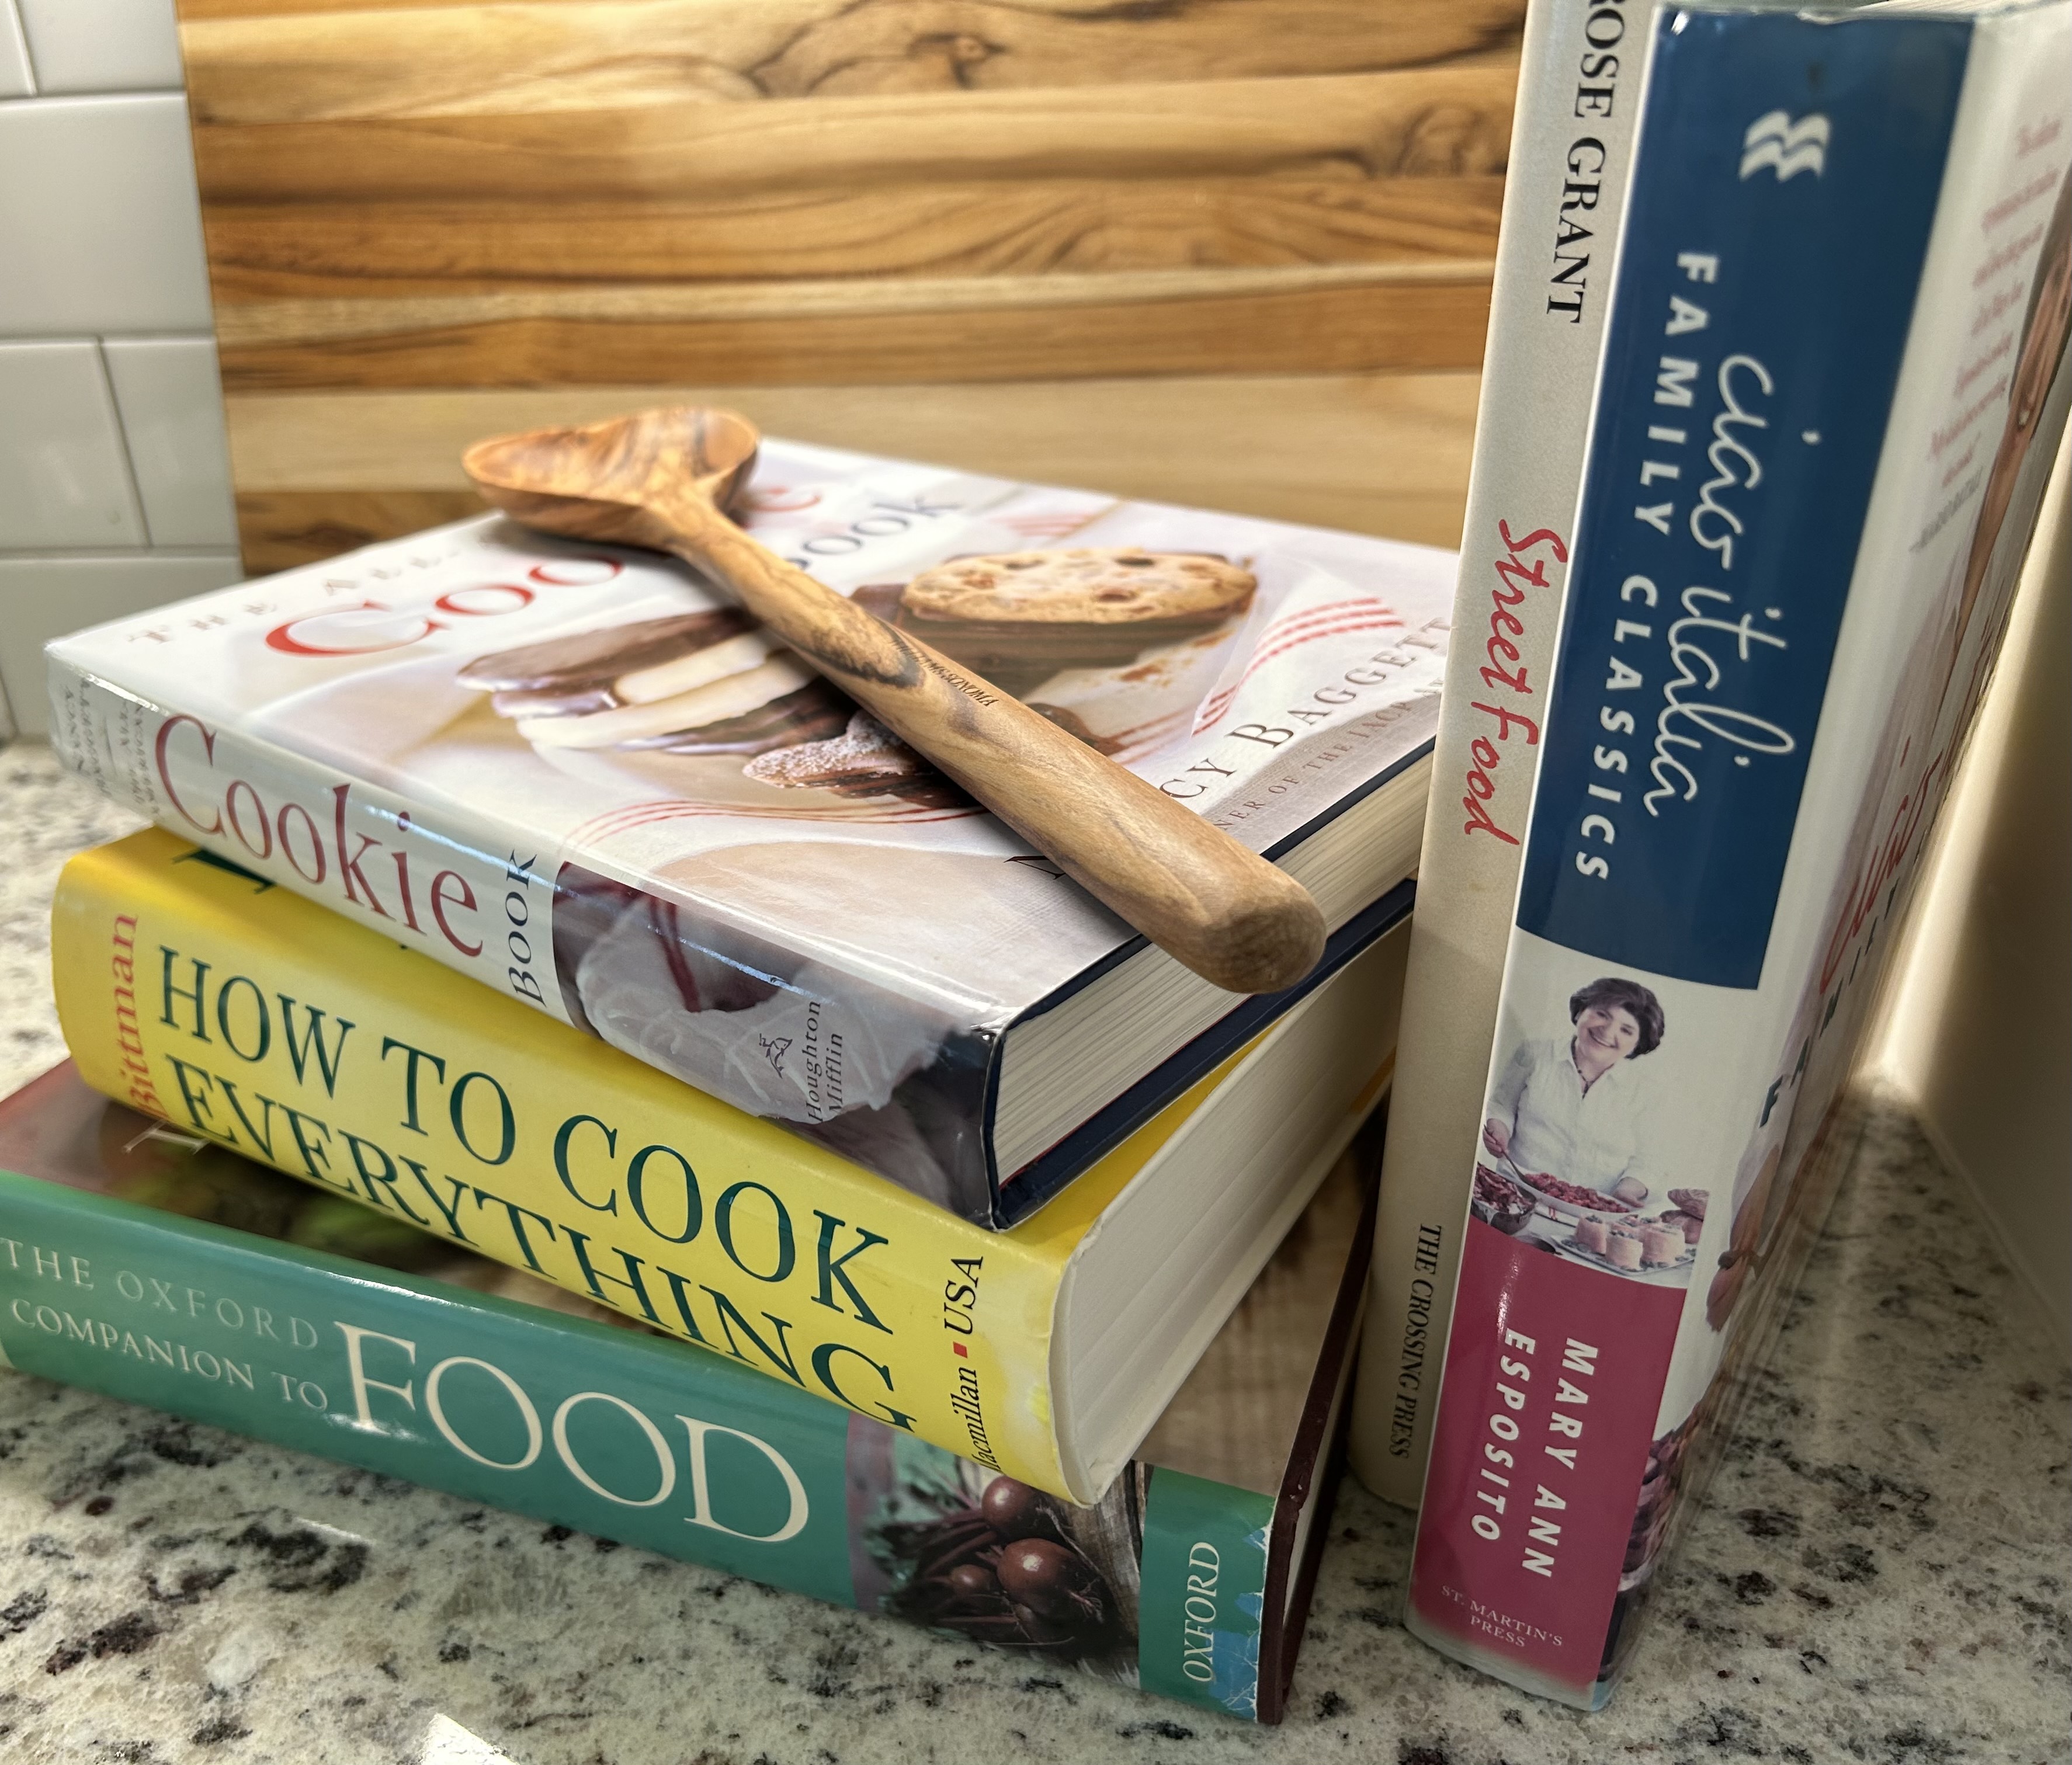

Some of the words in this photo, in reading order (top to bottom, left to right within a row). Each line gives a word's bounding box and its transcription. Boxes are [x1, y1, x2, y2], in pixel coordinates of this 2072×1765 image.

[1574, 0, 1625, 117] OSE
[1547, 136, 1606, 325] GRANT
[1635, 252, 1720, 535] FAMILY
[1689, 355, 1822, 571] ciao
[1478, 519, 1568, 694] Street
[1224, 617, 1451, 749] BAGGETT
[1575, 575, 1658, 881] CLASSICS
[1643, 586, 1796, 817] italia
[1268, 775, 1300, 794] OF
[1304, 742, 1351, 772] THE
[155, 714, 483, 957] Cookie
[505, 849, 547, 1008] BOOK
[112, 915, 169, 1118] Bittman
[801, 1001, 824, 1123] Houghton
[825, 1033, 844, 1113] Mifflin
[159, 944, 356, 1099] HOW
[381, 1036, 516, 1166] TO
[553, 1114, 894, 1336] COOK
[0, 1237, 94, 1291] THE
[116, 1270, 319, 1351] OXFORD
[165, 1053, 918, 1433] EVERYTHING
[944, 1256, 984, 1336] USA
[1414, 1224, 1442, 1276] THE
[11, 1298, 255, 1391] COMPANION
[270, 1371, 329, 1411] TO
[1398, 1278, 1434, 1391] CROSSING
[335, 1321, 809, 1543] FOOD
[1389, 1391, 1418, 1460] PRESS
[1470, 1328, 1536, 1541] ESPOSITO
[1545, 1337, 1599, 1471] MARY
[1522, 1484, 1568, 1578] ANN
[1182, 1541, 1221, 1682] OXFORD
[1441, 1585, 1465, 1606] ST.
[1470, 1600, 1563, 1646] MARTIN'S
[1470, 1615, 1526, 1647] PRESS
